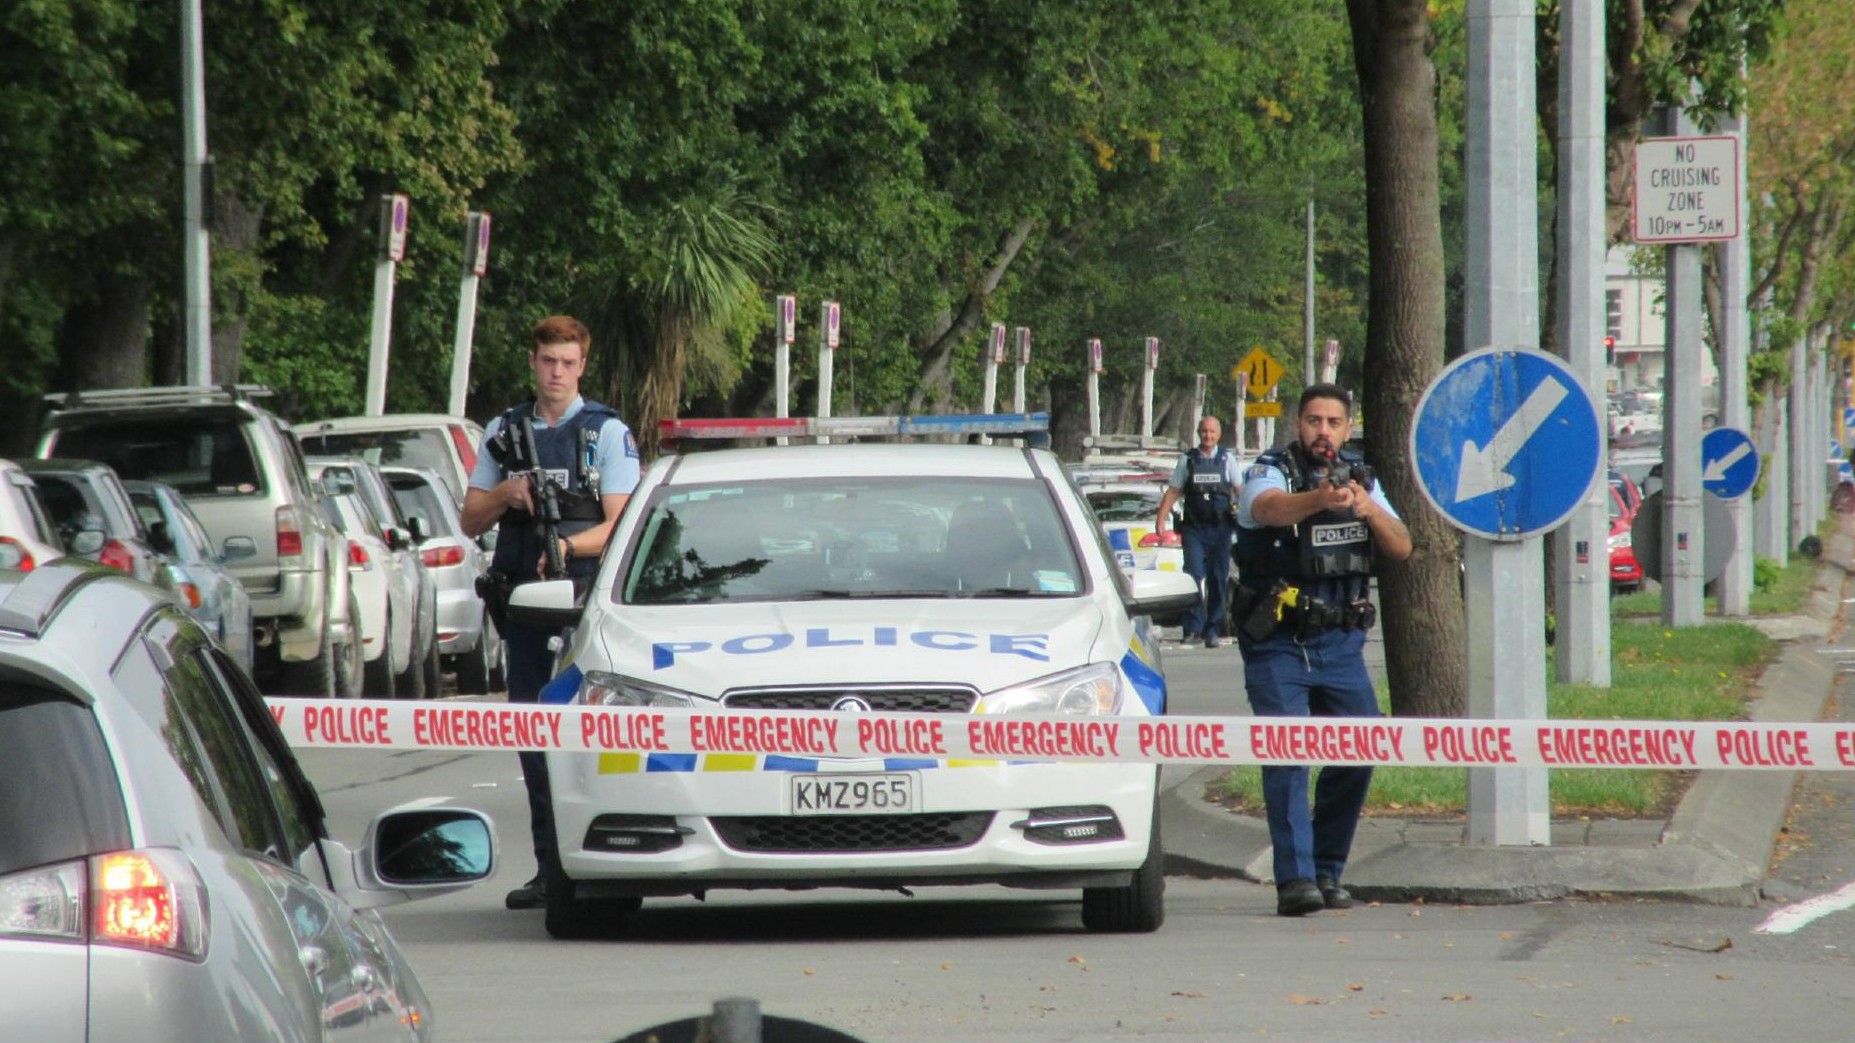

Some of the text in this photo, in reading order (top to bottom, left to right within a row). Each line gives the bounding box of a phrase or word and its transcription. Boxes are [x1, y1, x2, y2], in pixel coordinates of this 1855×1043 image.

[1675, 143, 1696, 164] NO
[1651, 166, 1721, 188] CRUISING
[1667, 191, 1705, 212] ZONE
[1316, 526, 1365, 543] POLICE
[652, 627, 1051, 671] POLICE
[304, 705, 393, 745] POLICE
[413, 707, 563, 749] EMERGENCY
[580, 711, 669, 751] POLICE
[689, 715, 839, 754] EMERGENCY
[857, 718, 946, 755] POLICE
[967, 720, 1120, 758] EMERGENCY
[1138, 723, 1230, 760] POLICE
[1250, 724, 1406, 762] EMERGENCY
[1422, 726, 1518, 764] POLICE
[1537, 727, 1698, 766] EMERGENCY
[1715, 729, 1815, 767] POLICE
[796, 780, 908, 811] KMZ965
